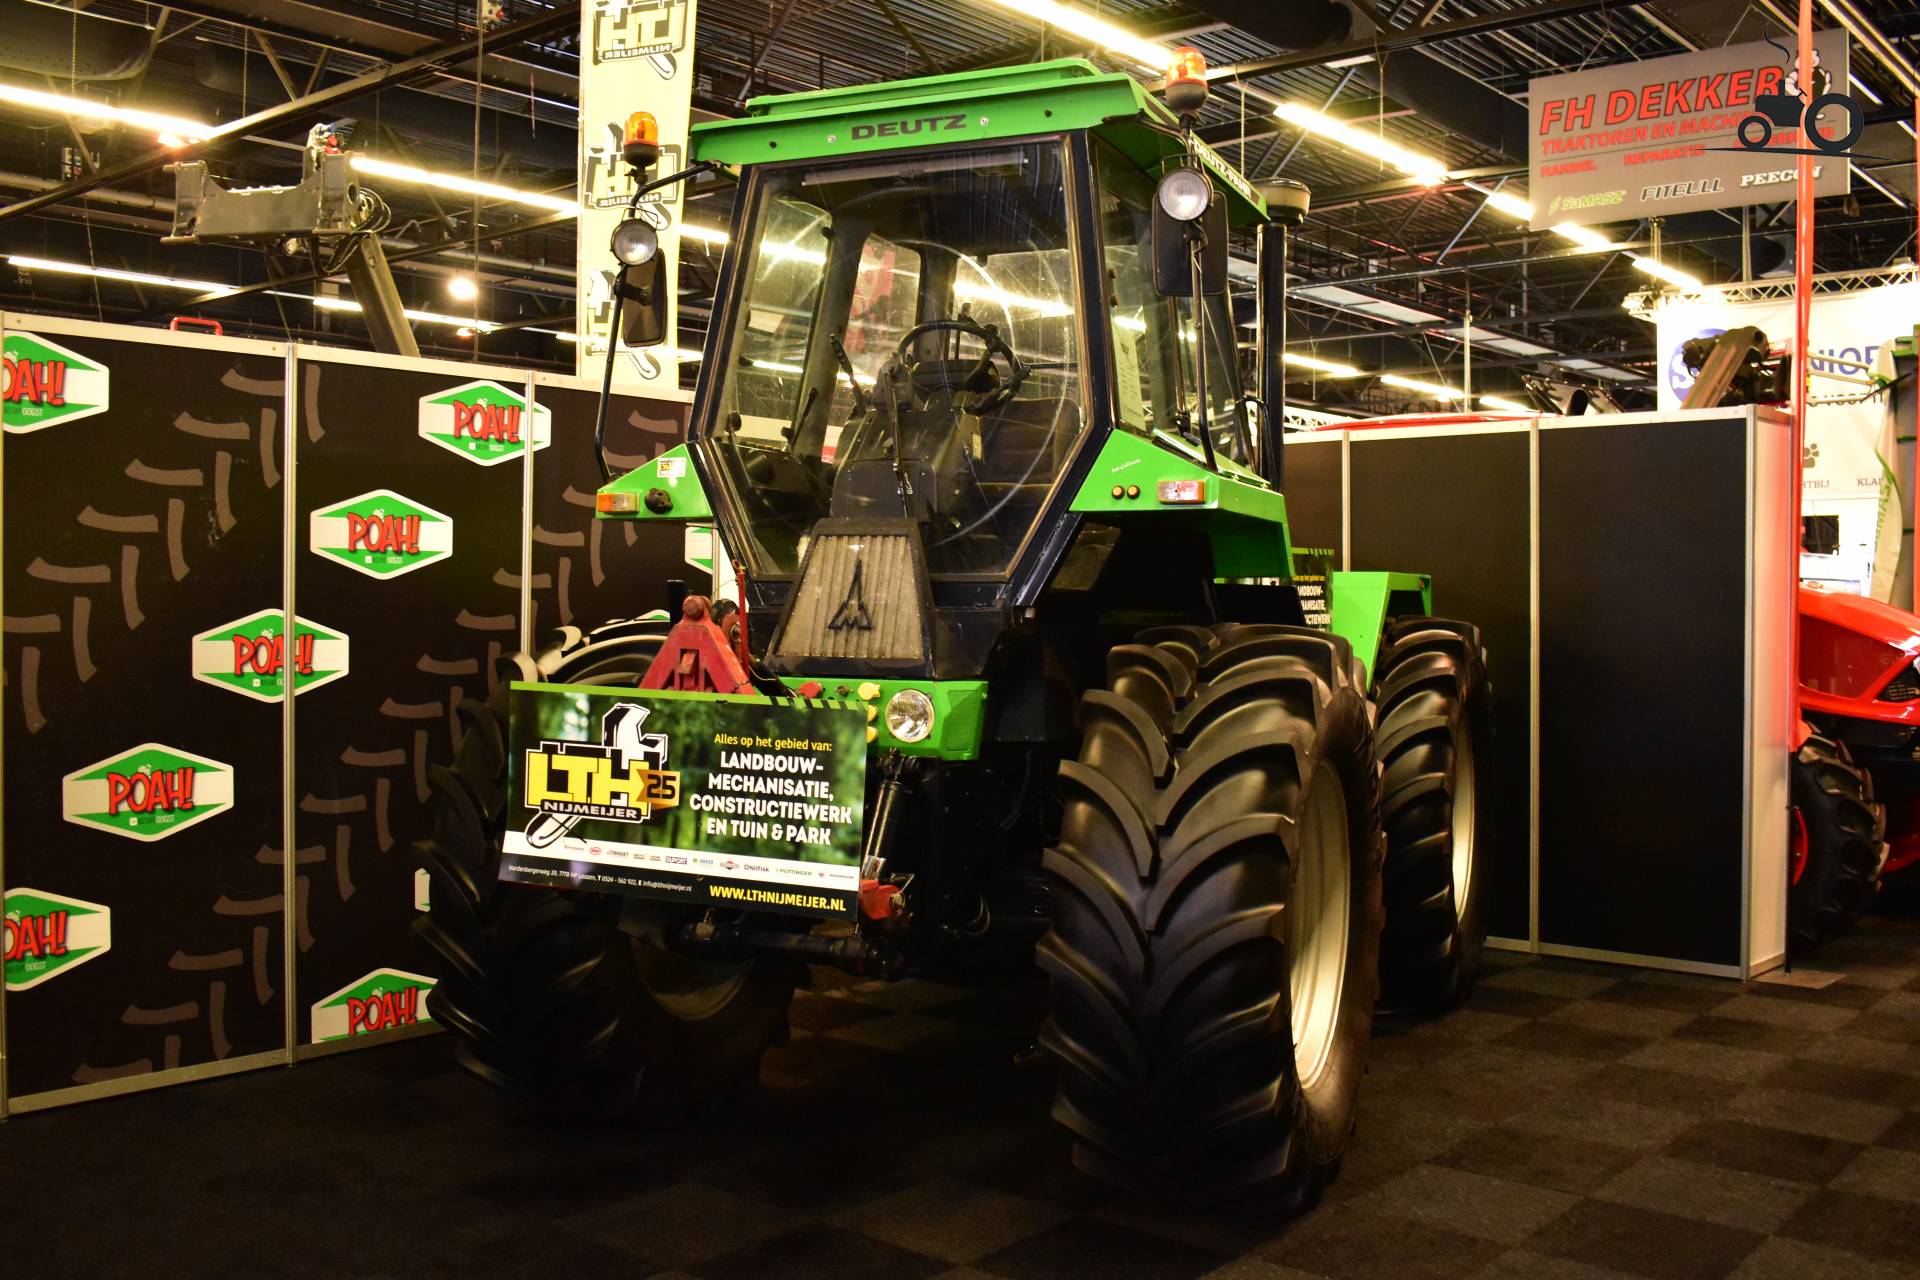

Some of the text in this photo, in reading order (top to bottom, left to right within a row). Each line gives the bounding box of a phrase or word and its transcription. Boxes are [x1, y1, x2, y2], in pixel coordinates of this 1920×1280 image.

[1539, 65, 1784, 136] FH DEKKER
[851, 113, 967, 140] DEUTZ
[1542, 127, 1648, 156] TRAKTOREN
[1651, 121, 1677, 140] EN
[452, 399, 521, 444] POAH!
[346, 511, 421, 555] POAH!
[714, 733, 833, 752] Alles op het gebied van:
[720, 751, 824, 775] LANDBOUW-
[107, 766, 195, 817] POAH!
[527, 751, 650, 816] LTH
[647, 773, 677, 800] 25
[708, 772, 834, 802] MECHANISATIE,
[543, 801, 638, 819] NIJMEIJER
[689, 793, 853, 824] CONSTRUCTIEWERK
[706, 817, 831, 845] EN TUIN & PARK
[709, 884, 847, 912] WWW.LTHNIJMEIJER.NL
[347, 985, 417, 1037] POAH!
